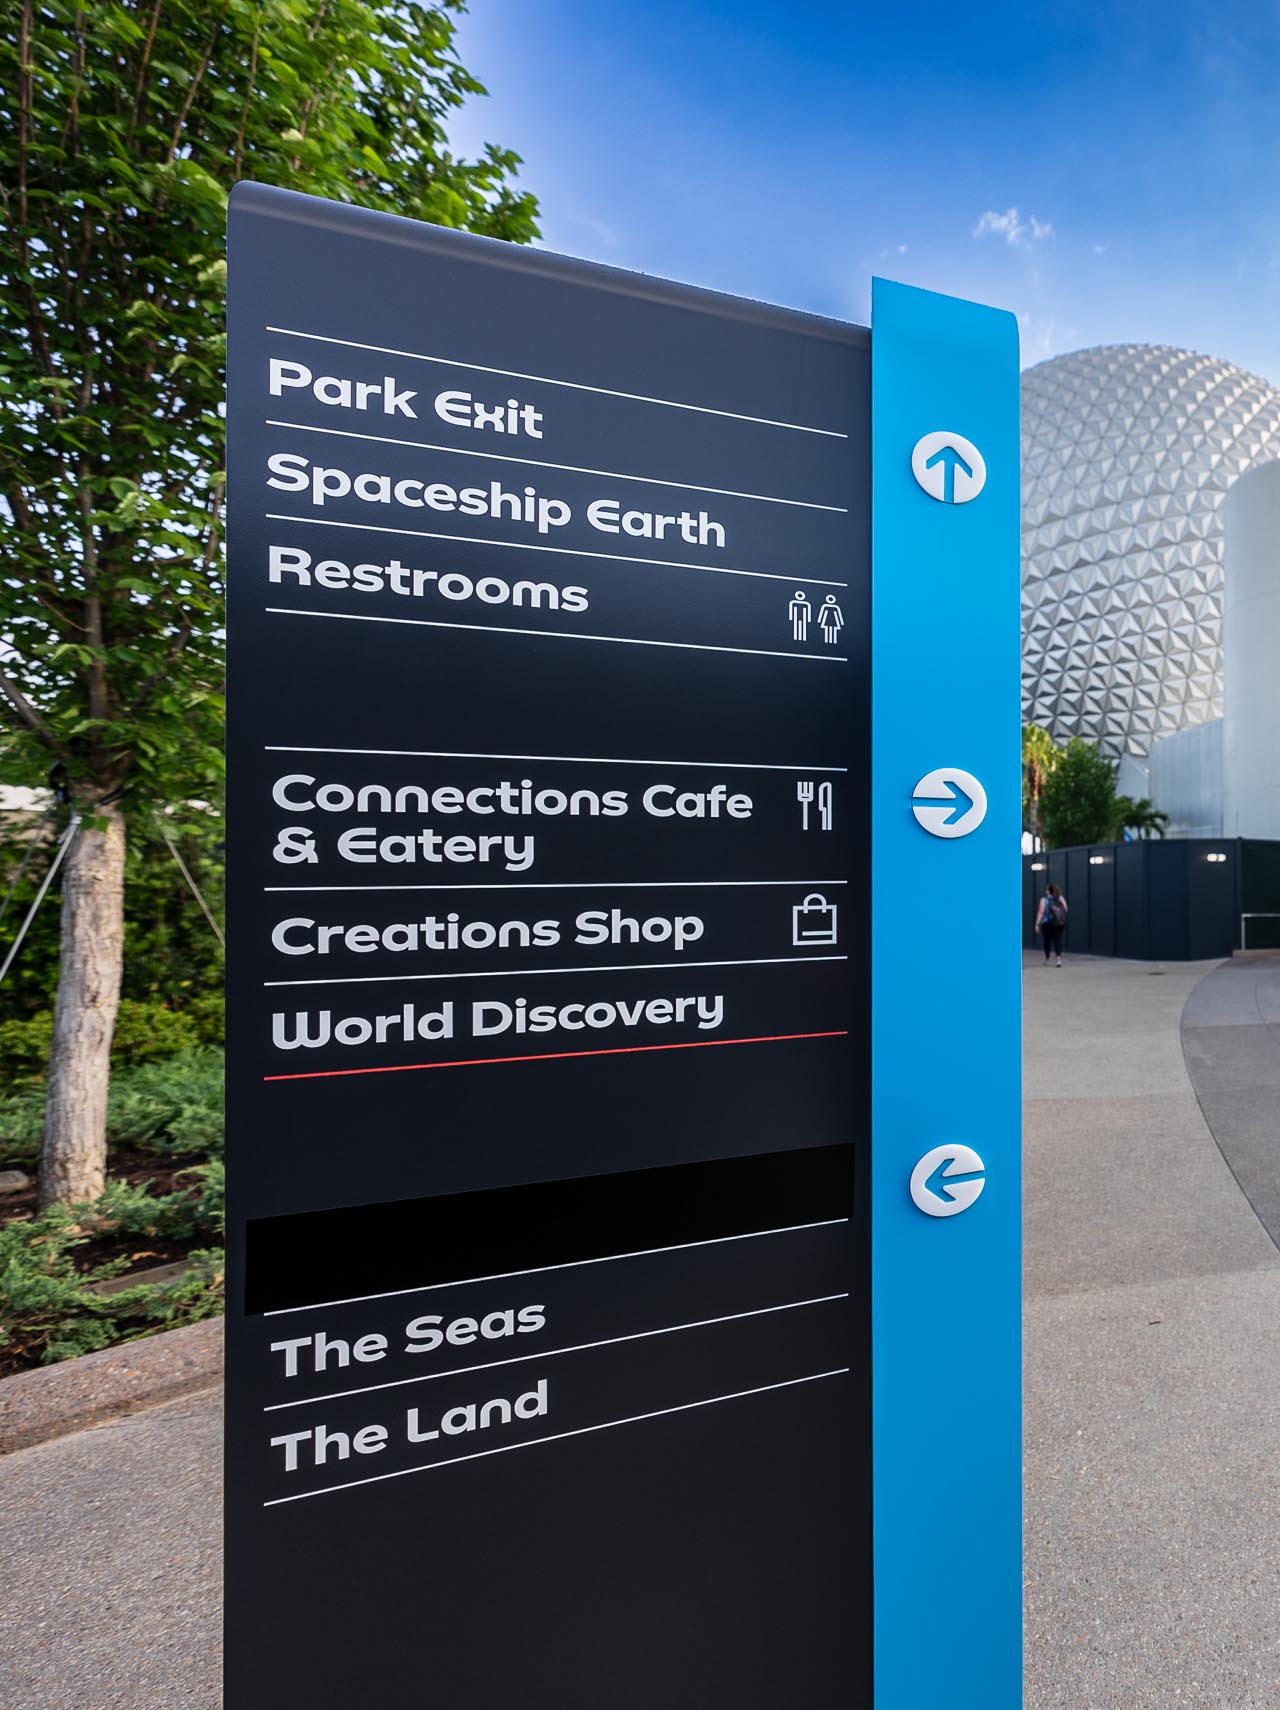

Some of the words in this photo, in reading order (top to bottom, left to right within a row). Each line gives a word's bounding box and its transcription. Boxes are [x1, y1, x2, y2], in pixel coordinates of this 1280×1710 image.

[269, 357, 418, 419] Park
[434, 390, 544, 440] Exit
[266, 453, 572, 534] Spaceship
[586, 499, 726, 548] Earth
[268, 545, 589, 612] Restrooms
[272, 774, 629, 817] Connections
[642, 784, 753, 819] Cafe
[272, 826, 319, 864] &
[337, 827, 535, 872] Eatery
[271, 912, 561, 956] Creations
[574, 908, 704, 951] Shop
[272, 1001, 454, 1050] World
[472, 995, 724, 1037] Discovery
[270, 1331, 388, 1378] The
[404, 1304, 546, 1353] Seas
[270, 1424, 389, 1472] The
[407, 1378, 548, 1443] Land
